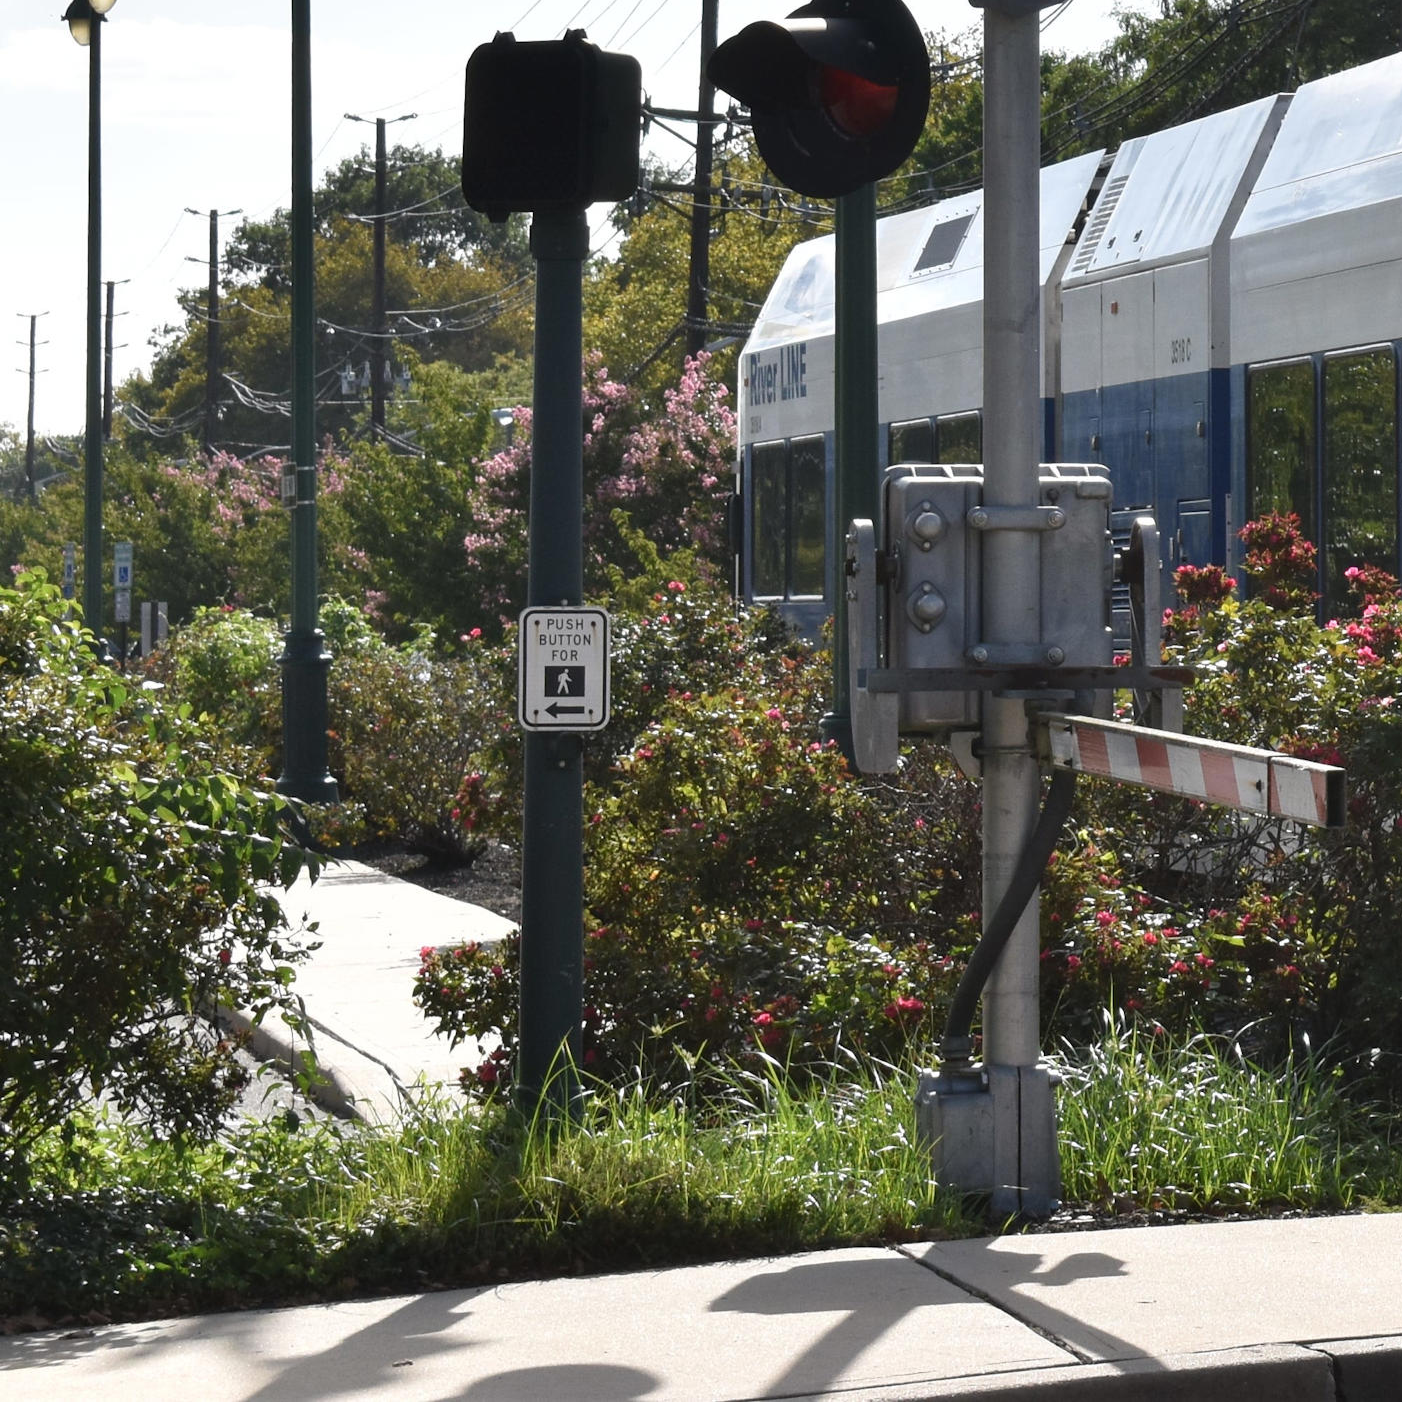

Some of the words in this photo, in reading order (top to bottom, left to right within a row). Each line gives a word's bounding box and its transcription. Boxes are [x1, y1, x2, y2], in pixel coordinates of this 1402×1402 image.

[750, 352, 778, 406] River
[780, 342, 807, 401] LINE
[547, 618, 584, 630] PUSH
[539, 634, 591, 646] BUTTON
[552, 649, 578, 662] FOR
